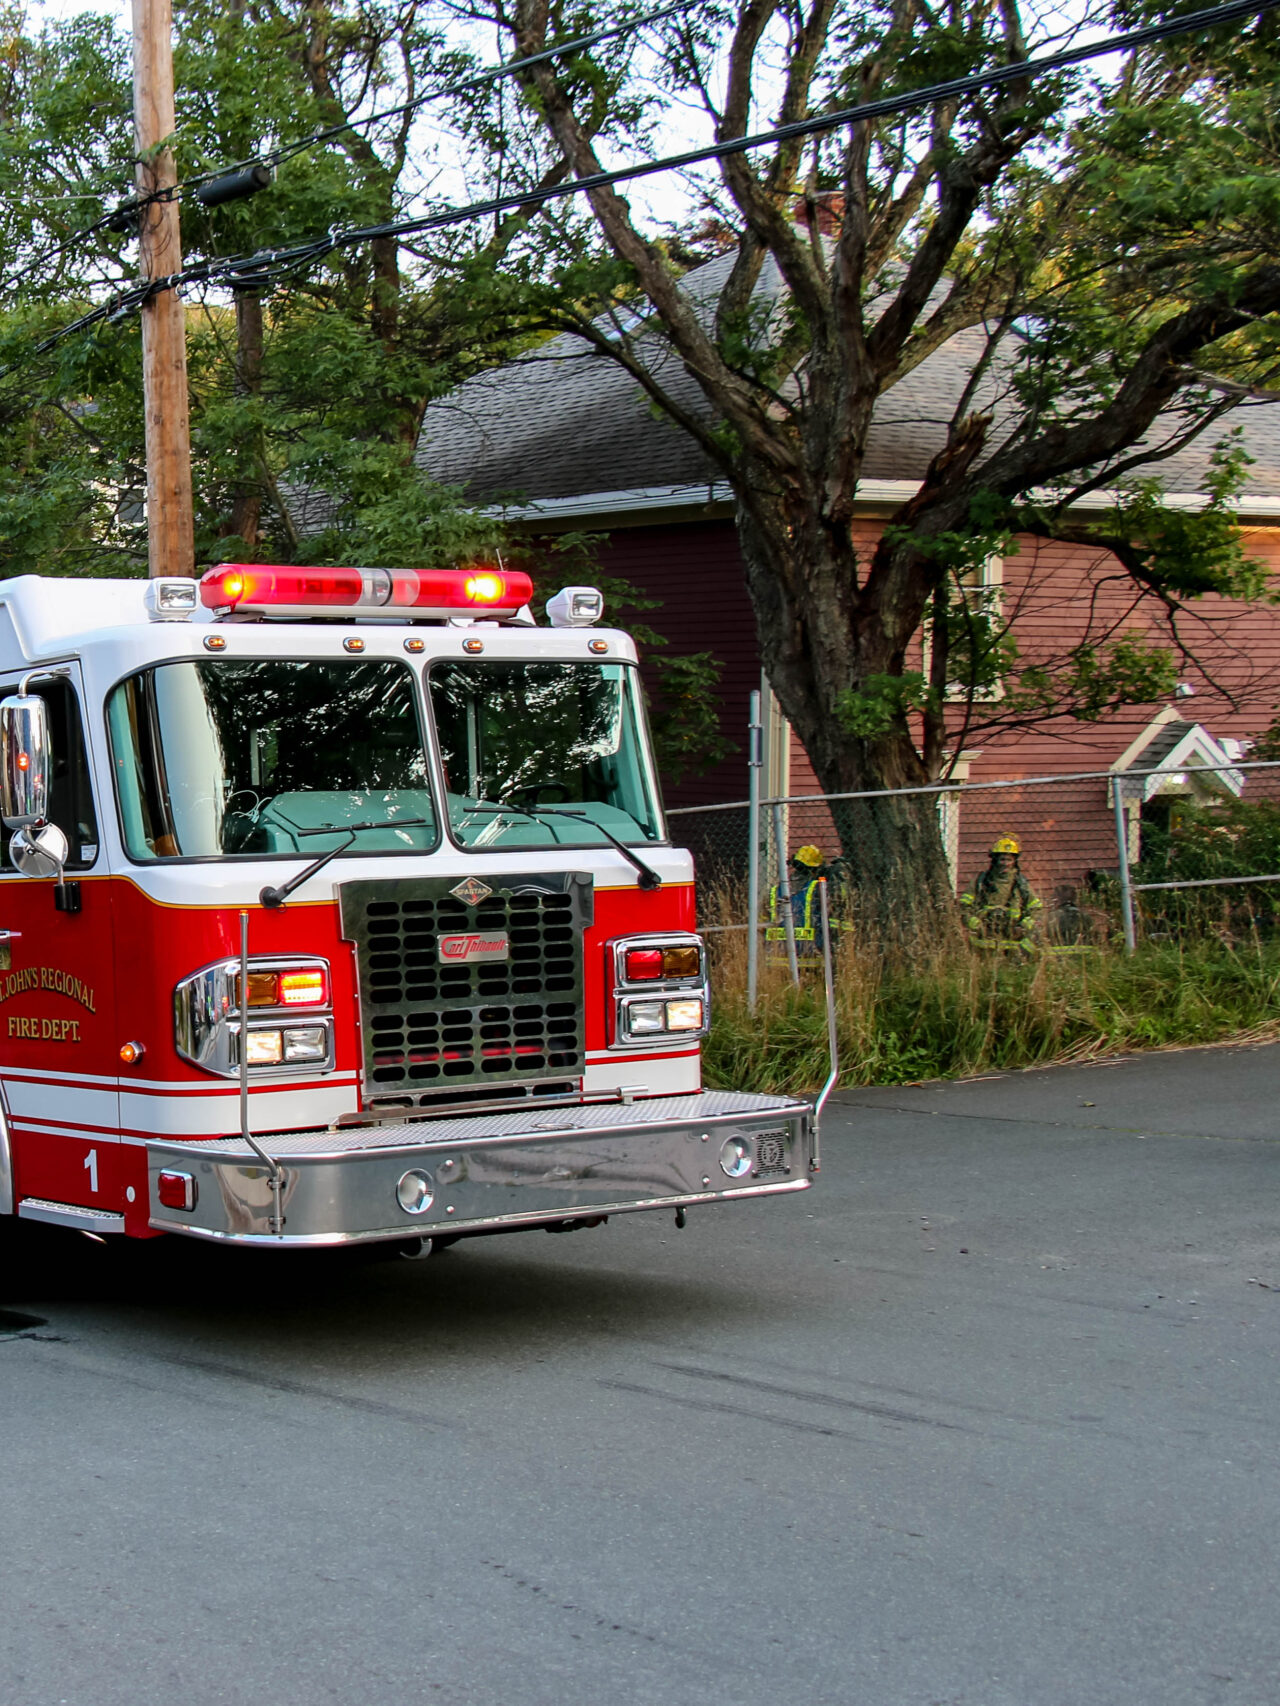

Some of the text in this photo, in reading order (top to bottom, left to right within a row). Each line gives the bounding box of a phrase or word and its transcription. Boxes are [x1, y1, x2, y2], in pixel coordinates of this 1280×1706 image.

[455, 888, 488, 896] SPARTAN
[41, 967, 96, 1013] REGIONAL
[8, 1016, 81, 1042] FIRE DEPT.
[84, 1149, 98, 1193] 1
